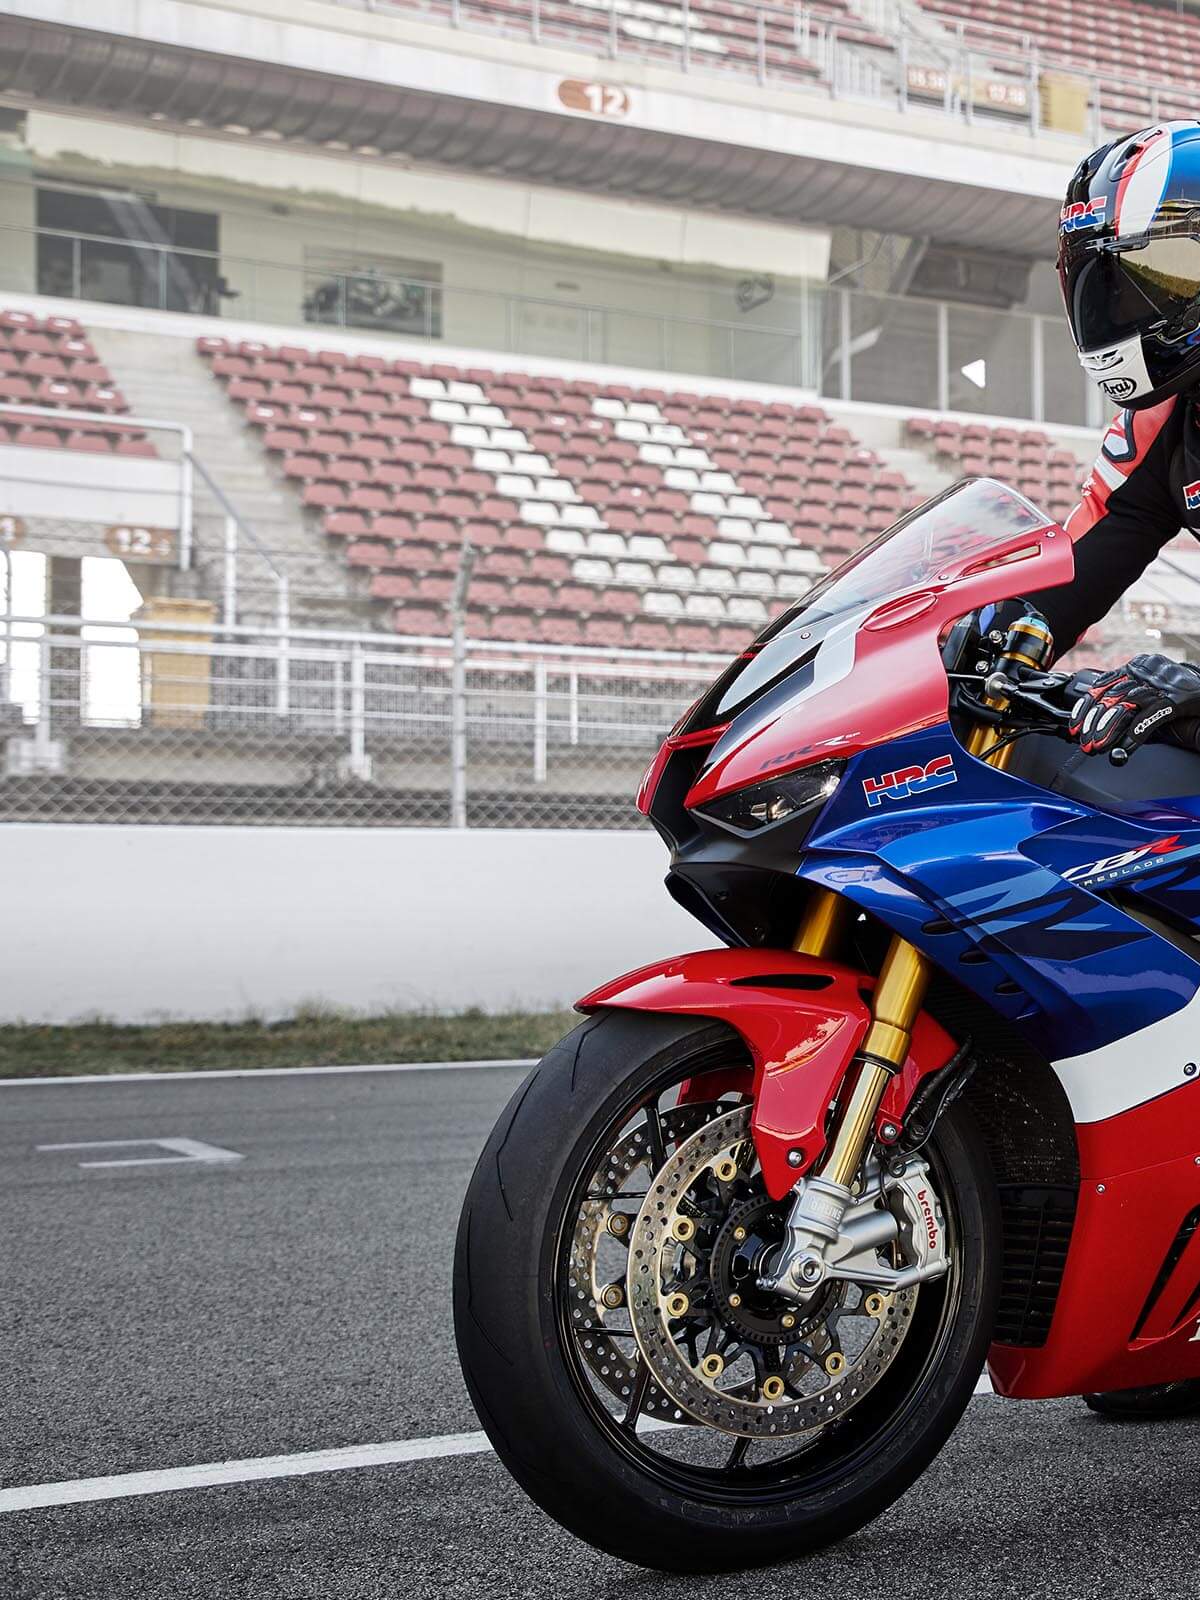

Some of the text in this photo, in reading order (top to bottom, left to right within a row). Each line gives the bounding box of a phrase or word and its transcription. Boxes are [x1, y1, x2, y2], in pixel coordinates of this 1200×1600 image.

[583, 85, 627, 113] 12
[1103, 379, 1132, 395] Arai
[862, 754, 958, 808] HRC
[917, 1189, 939, 1249] brembo
